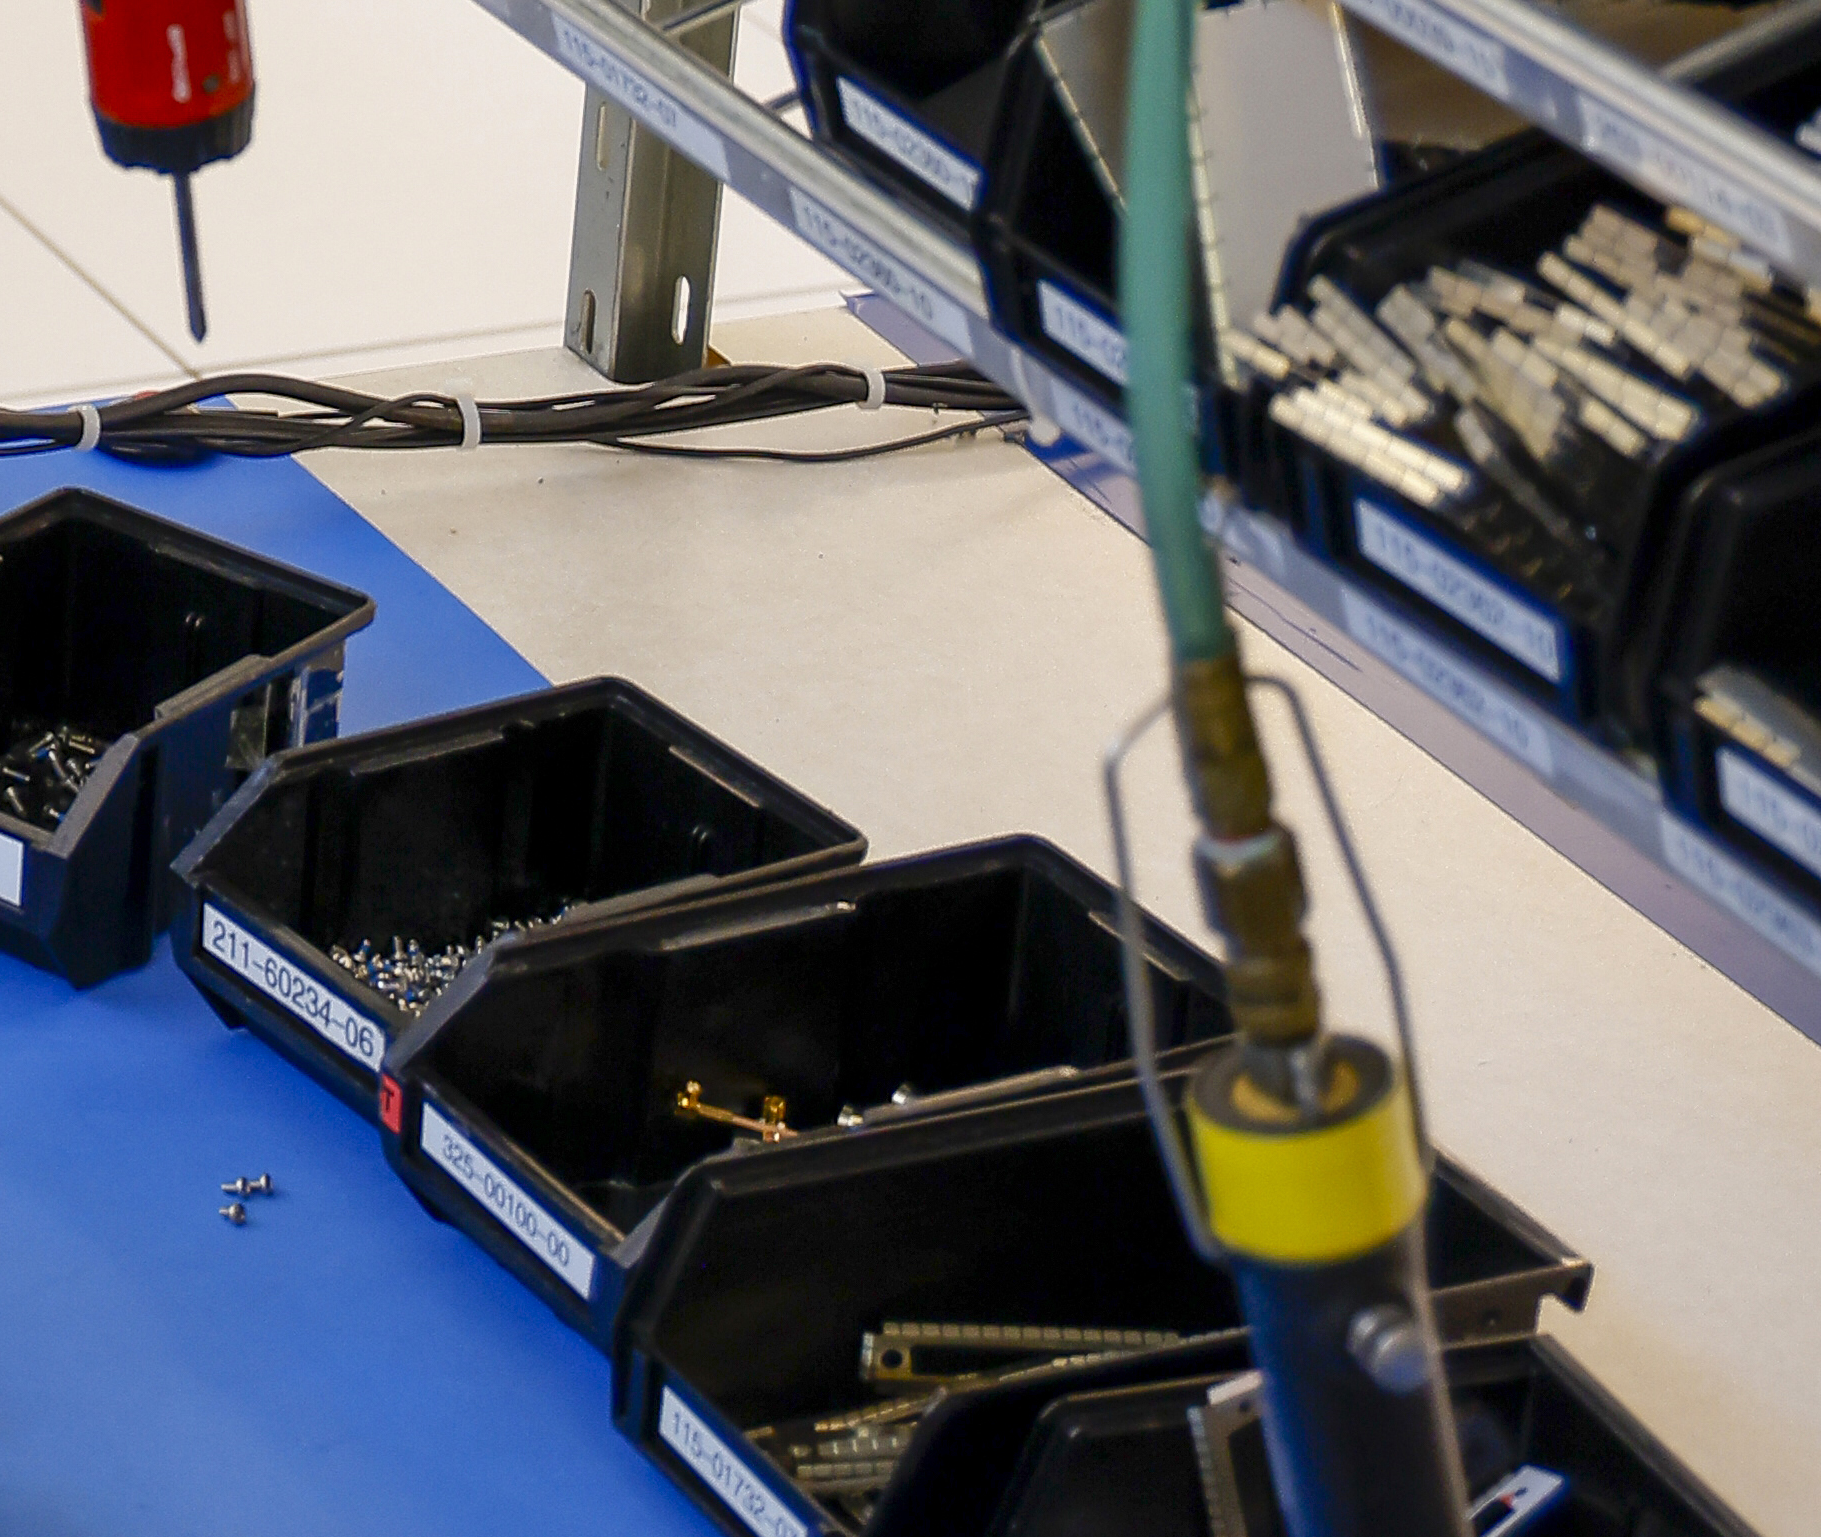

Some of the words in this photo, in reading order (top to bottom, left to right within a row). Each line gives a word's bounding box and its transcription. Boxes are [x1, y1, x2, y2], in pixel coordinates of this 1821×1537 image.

[211, 919, 375, 1060] 211-60234-06
[383, 1087, 398, 1116] T
[442, 1132, 571, 1268] 325-00100-00
